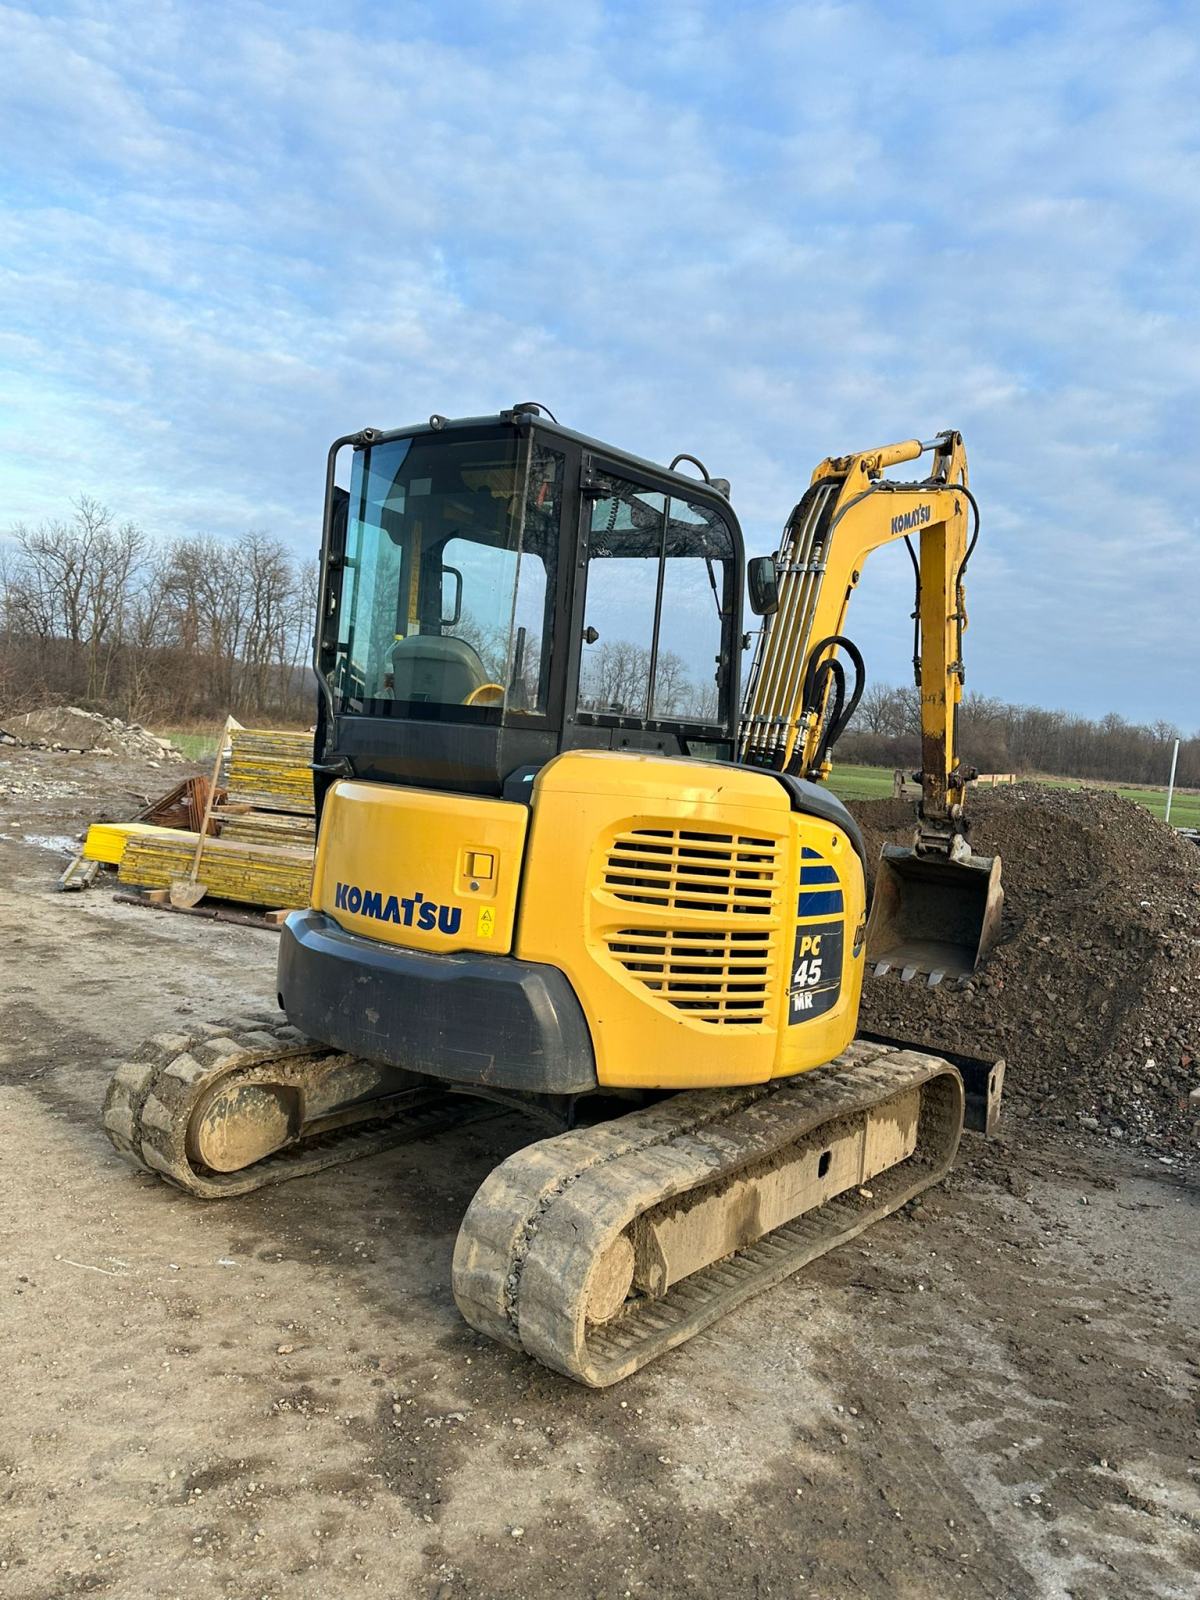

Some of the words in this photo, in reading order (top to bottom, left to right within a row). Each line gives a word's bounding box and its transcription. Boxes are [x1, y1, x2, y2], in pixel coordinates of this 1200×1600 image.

[891, 503, 931, 535] KOMATSU
[335, 882, 462, 934] KOMATSU
[799, 935, 822, 957] PC
[793, 958, 822, 987] 45
[793, 991, 813, 1012] MR
